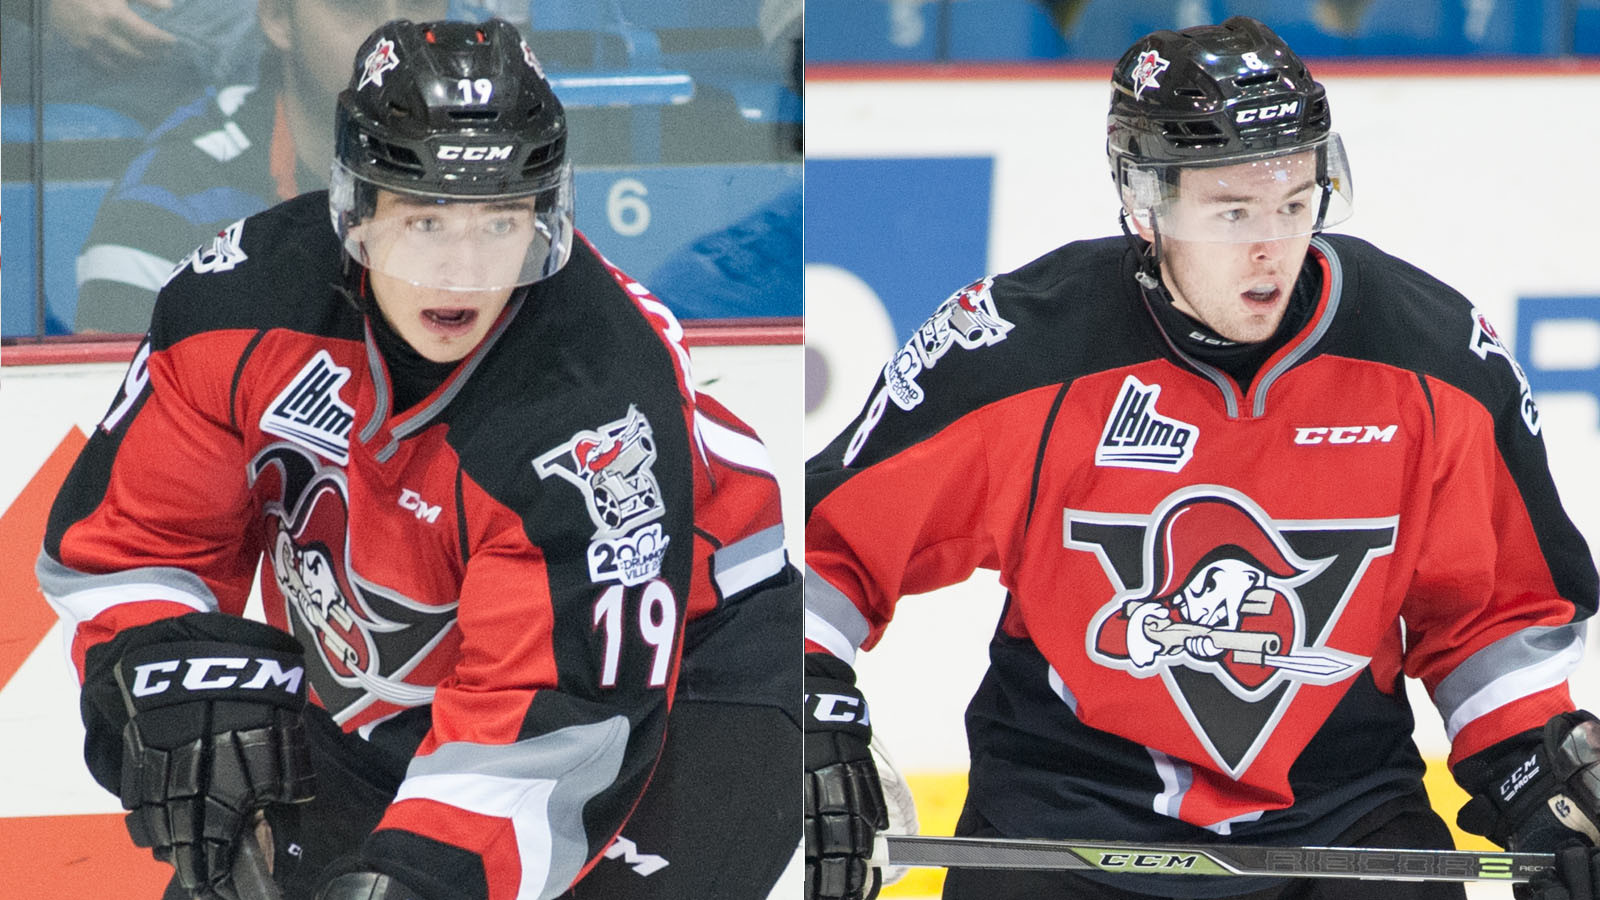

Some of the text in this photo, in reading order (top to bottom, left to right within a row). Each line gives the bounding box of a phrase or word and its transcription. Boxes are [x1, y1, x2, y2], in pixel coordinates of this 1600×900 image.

[457, 78, 493, 105] 19
[1235, 101, 1299, 123] CCM
[436, 145, 514, 161] CCM
[607, 178, 650, 236] 6
[1294, 424, 1398, 444] CCM
[592, 577, 678, 688] 19
[132, 657, 305, 698] CCM
[1500, 754, 1537, 796] CCM
[1513, 775, 1529, 793] PRO
[1099, 852, 1199, 869] CCM
